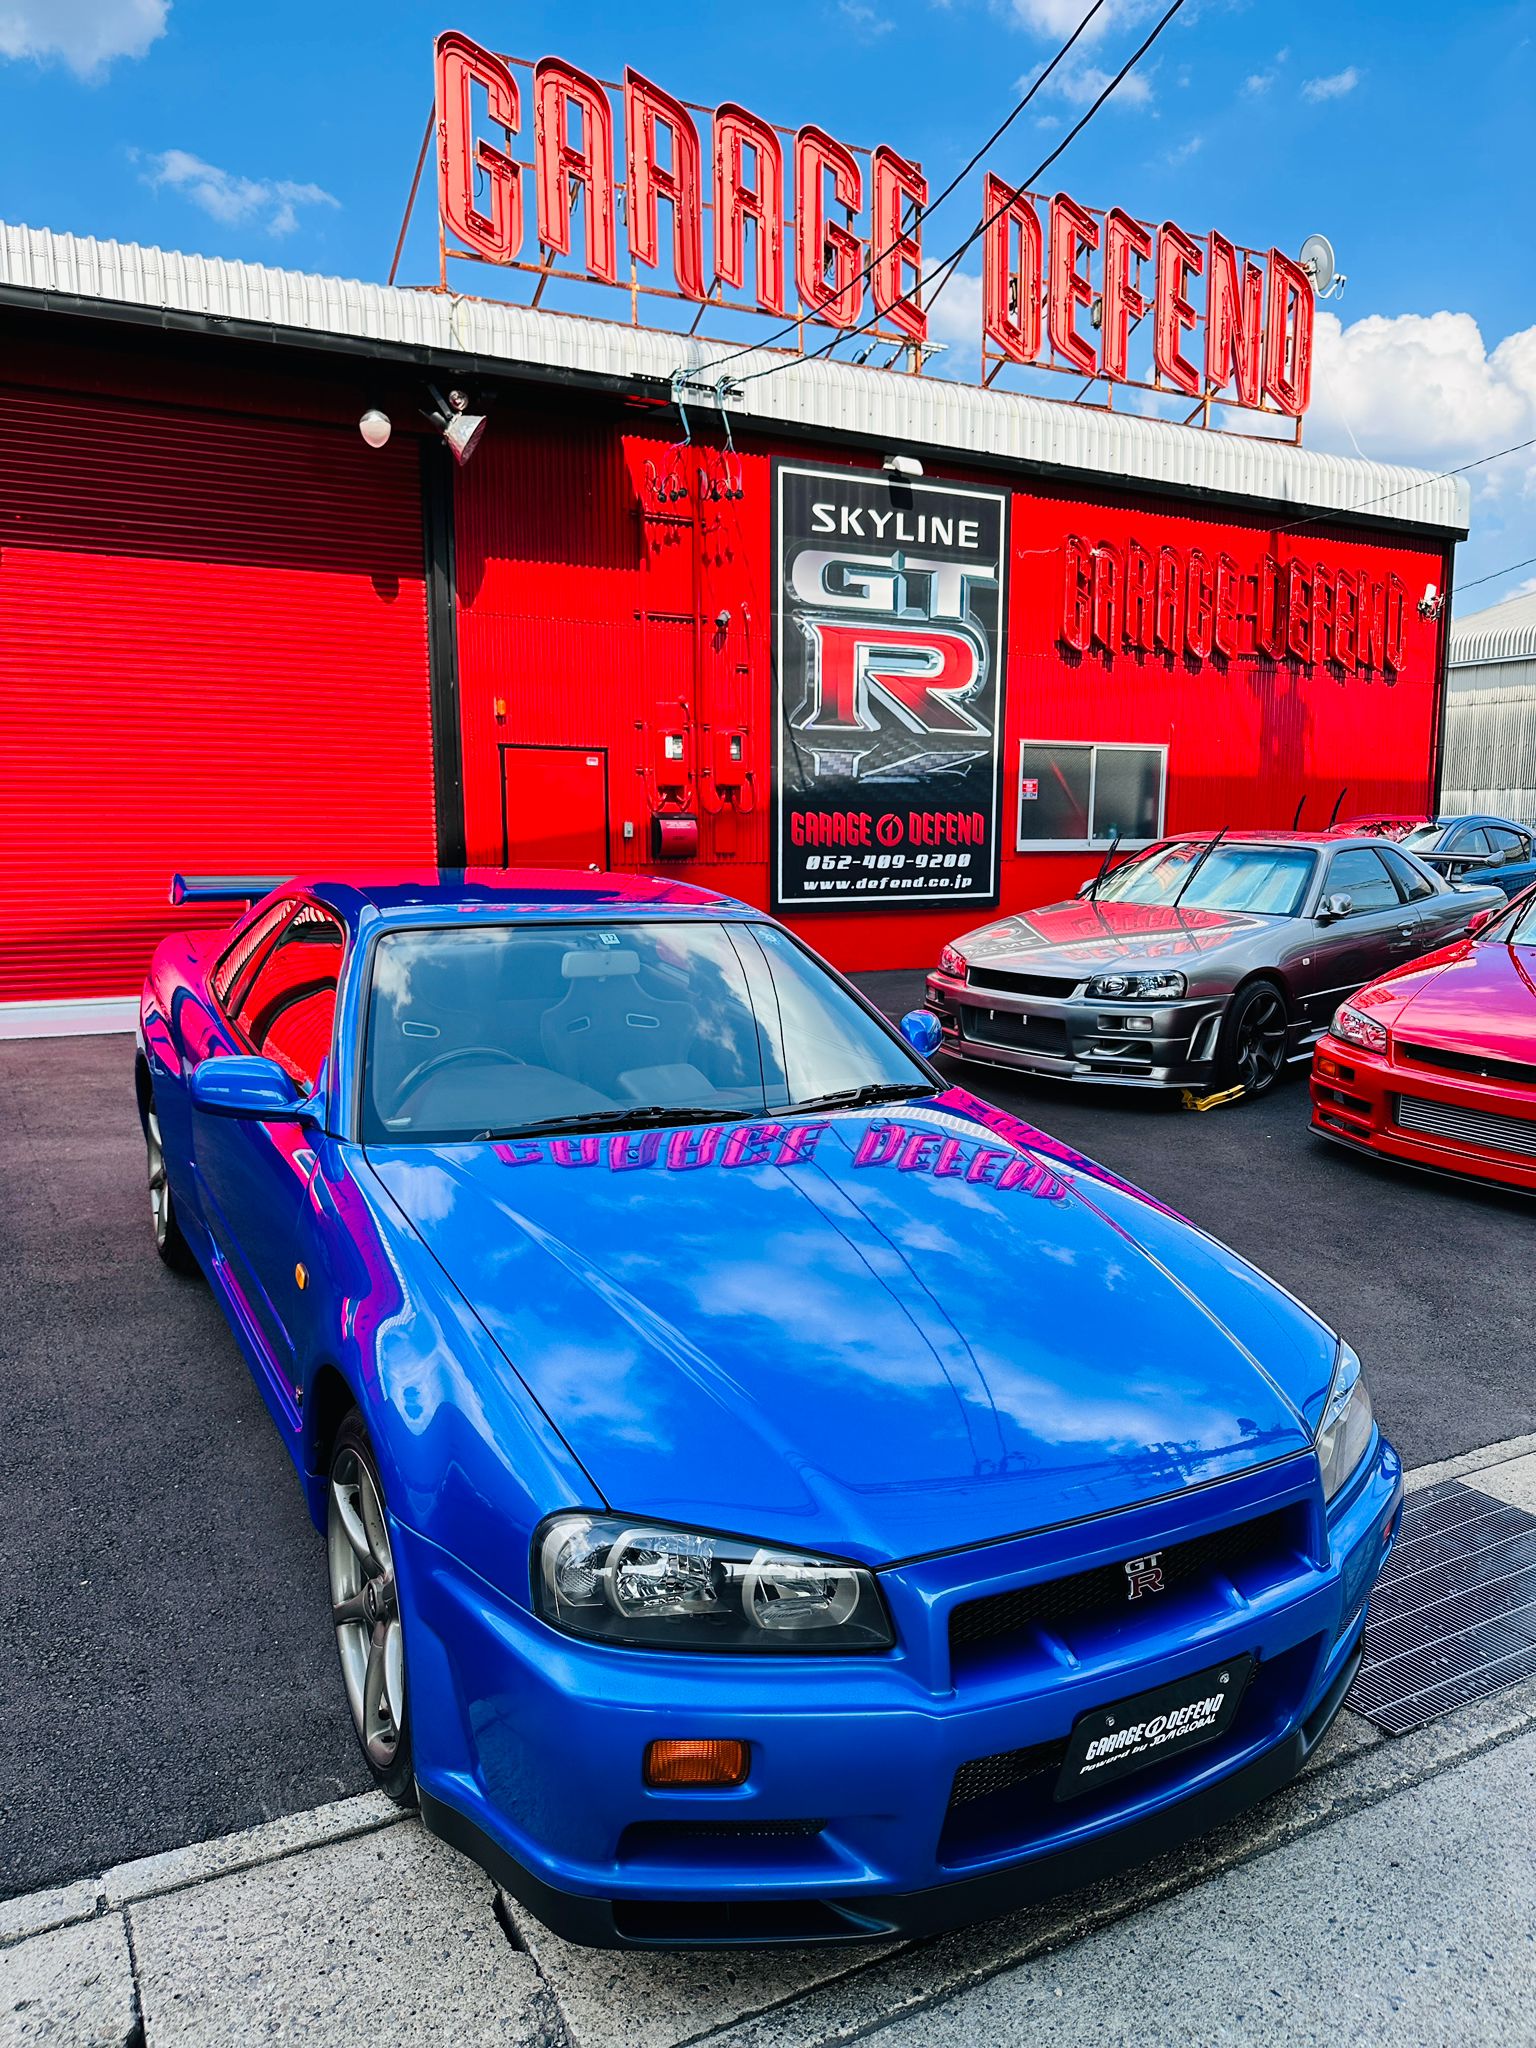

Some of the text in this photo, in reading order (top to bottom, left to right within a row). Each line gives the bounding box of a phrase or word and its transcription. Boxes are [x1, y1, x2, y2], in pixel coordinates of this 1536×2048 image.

[434, 30, 1315, 416] GARAGE DEFEND
[811, 503, 980, 549] SKYLINE
[1060, 534, 1408, 672] GARAGE DEFEND
[791, 811, 872, 848] GARAGE
[908, 811, 985, 847] DEFEND
[803, 875, 973, 891] www.defend.co.jp
[805, 854, 972, 871] 052-409-9200
[1125, 1552, 1163, 1574] GT
[1128, 1567, 1164, 1600] R
[1080, 1749, 1131, 1775] Powered
[1131, 1743, 1148, 1756] by
[1176, 1713, 1216, 1737] GLOBAL
[1085, 1723, 1147, 1761] GARAGE
[1166, 1693, 1225, 1730] DEFEND
